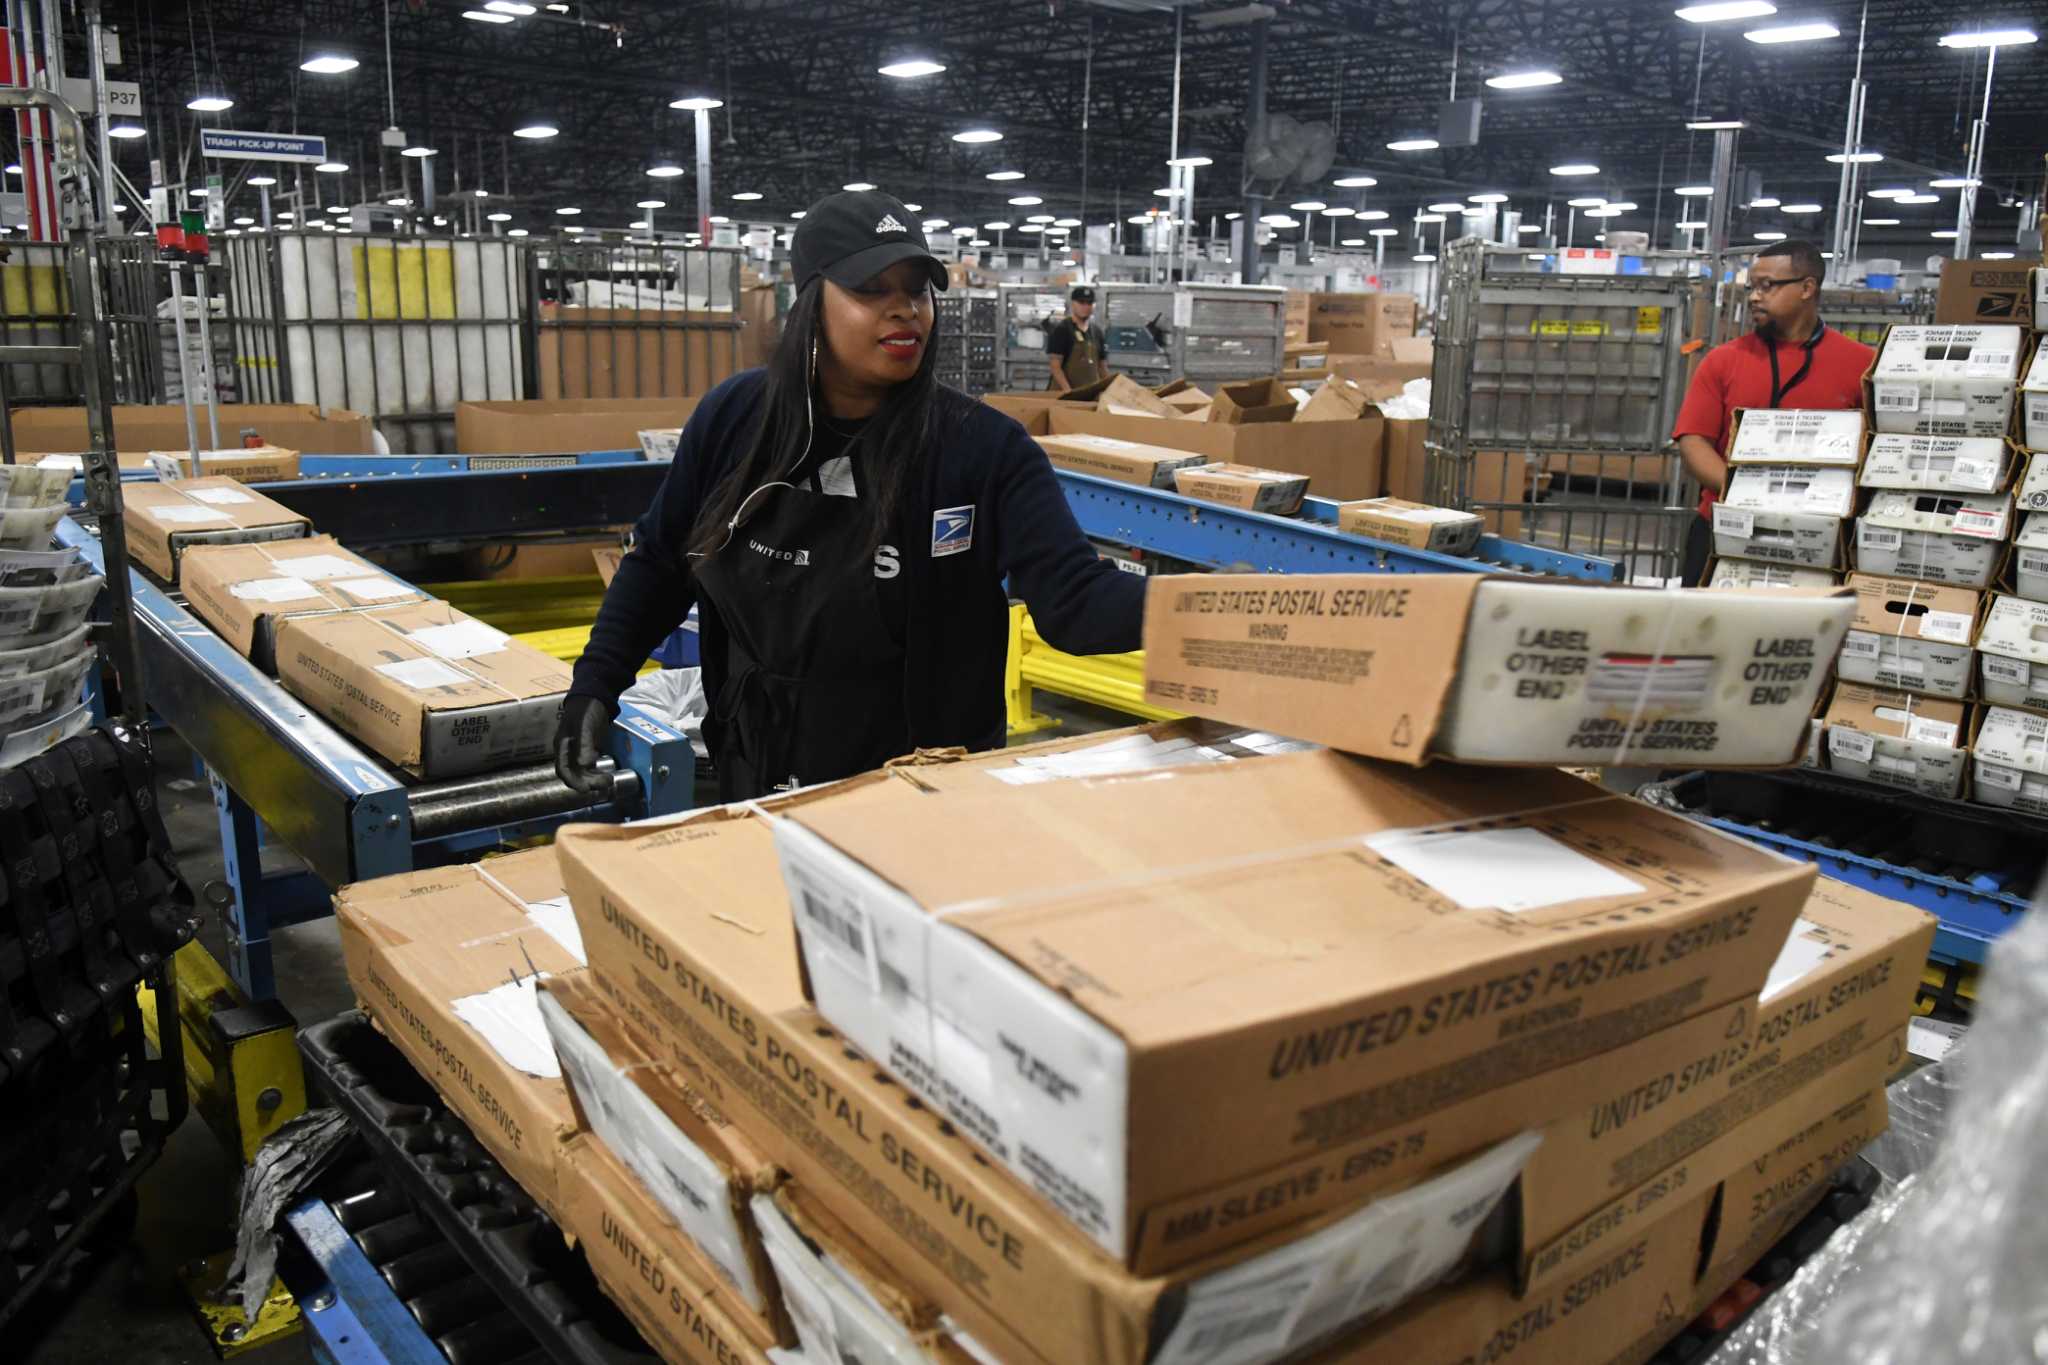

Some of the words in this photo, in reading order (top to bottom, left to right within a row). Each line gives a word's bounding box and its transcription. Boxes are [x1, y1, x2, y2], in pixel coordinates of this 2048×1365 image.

[110, 91, 137, 105] P37
[206, 137, 237, 147] TRASH
[238, 139, 276, 149] PICK-UP
[277, 142, 305, 151] POINT
[749, 539, 793, 562] UNITED
[1218, 590, 1267, 615] STATES
[1268, 589, 1325, 617] POSTAL
[1329, 588, 1412, 618] SERVICE
[1517, 627, 1591, 652] LABEL
[1753, 638, 1816, 658] LABEL
[1505, 652, 1588, 676] OTHER
[1743, 662, 1812, 682] OTHER
[1515, 678, 1566, 700] END
[1748, 686, 1792, 706] END
[451, 724, 489, 737] OTHER
[453, 715, 489, 729] LABEL
[1578, 717, 1647, 734] UNITD
[1649, 719, 1718, 735] STATES
[458, 735, 482, 747] END
[1640, 734, 1719, 751] SERVICE
[1268, 1004, 1414, 1081] UNITED
[1416, 967, 1541, 1037] STATES
[1543, 941, 1654, 997] POSTAL
[1657, 905, 1758, 966] SERVICE
[367, 961, 398, 1009] UNITED
[435, 1041, 477, 1095] POSTAL
[477, 1082, 524, 1151] SERVICE
[1590, 1071, 1676, 1140] UNITED
[1676, 1039, 1751, 1094] STATES
[1757, 996, 1821, 1045] POSTAL
[1825, 956, 1894, 1015] SERVICE
[601, 895, 669, 972] UNITED
[674, 961, 758, 1047] STATES
[766, 1034, 873, 1144] POSTAL
[880, 1131, 1024, 1272] SERVICE
[1217, 1166, 1324, 1226] SLEEVE
[1566, 1203, 1625, 1256] SLEEVE
[601, 1211, 665, 1295] UNITED
[1560, 1238, 1650, 1317] SERVICE
